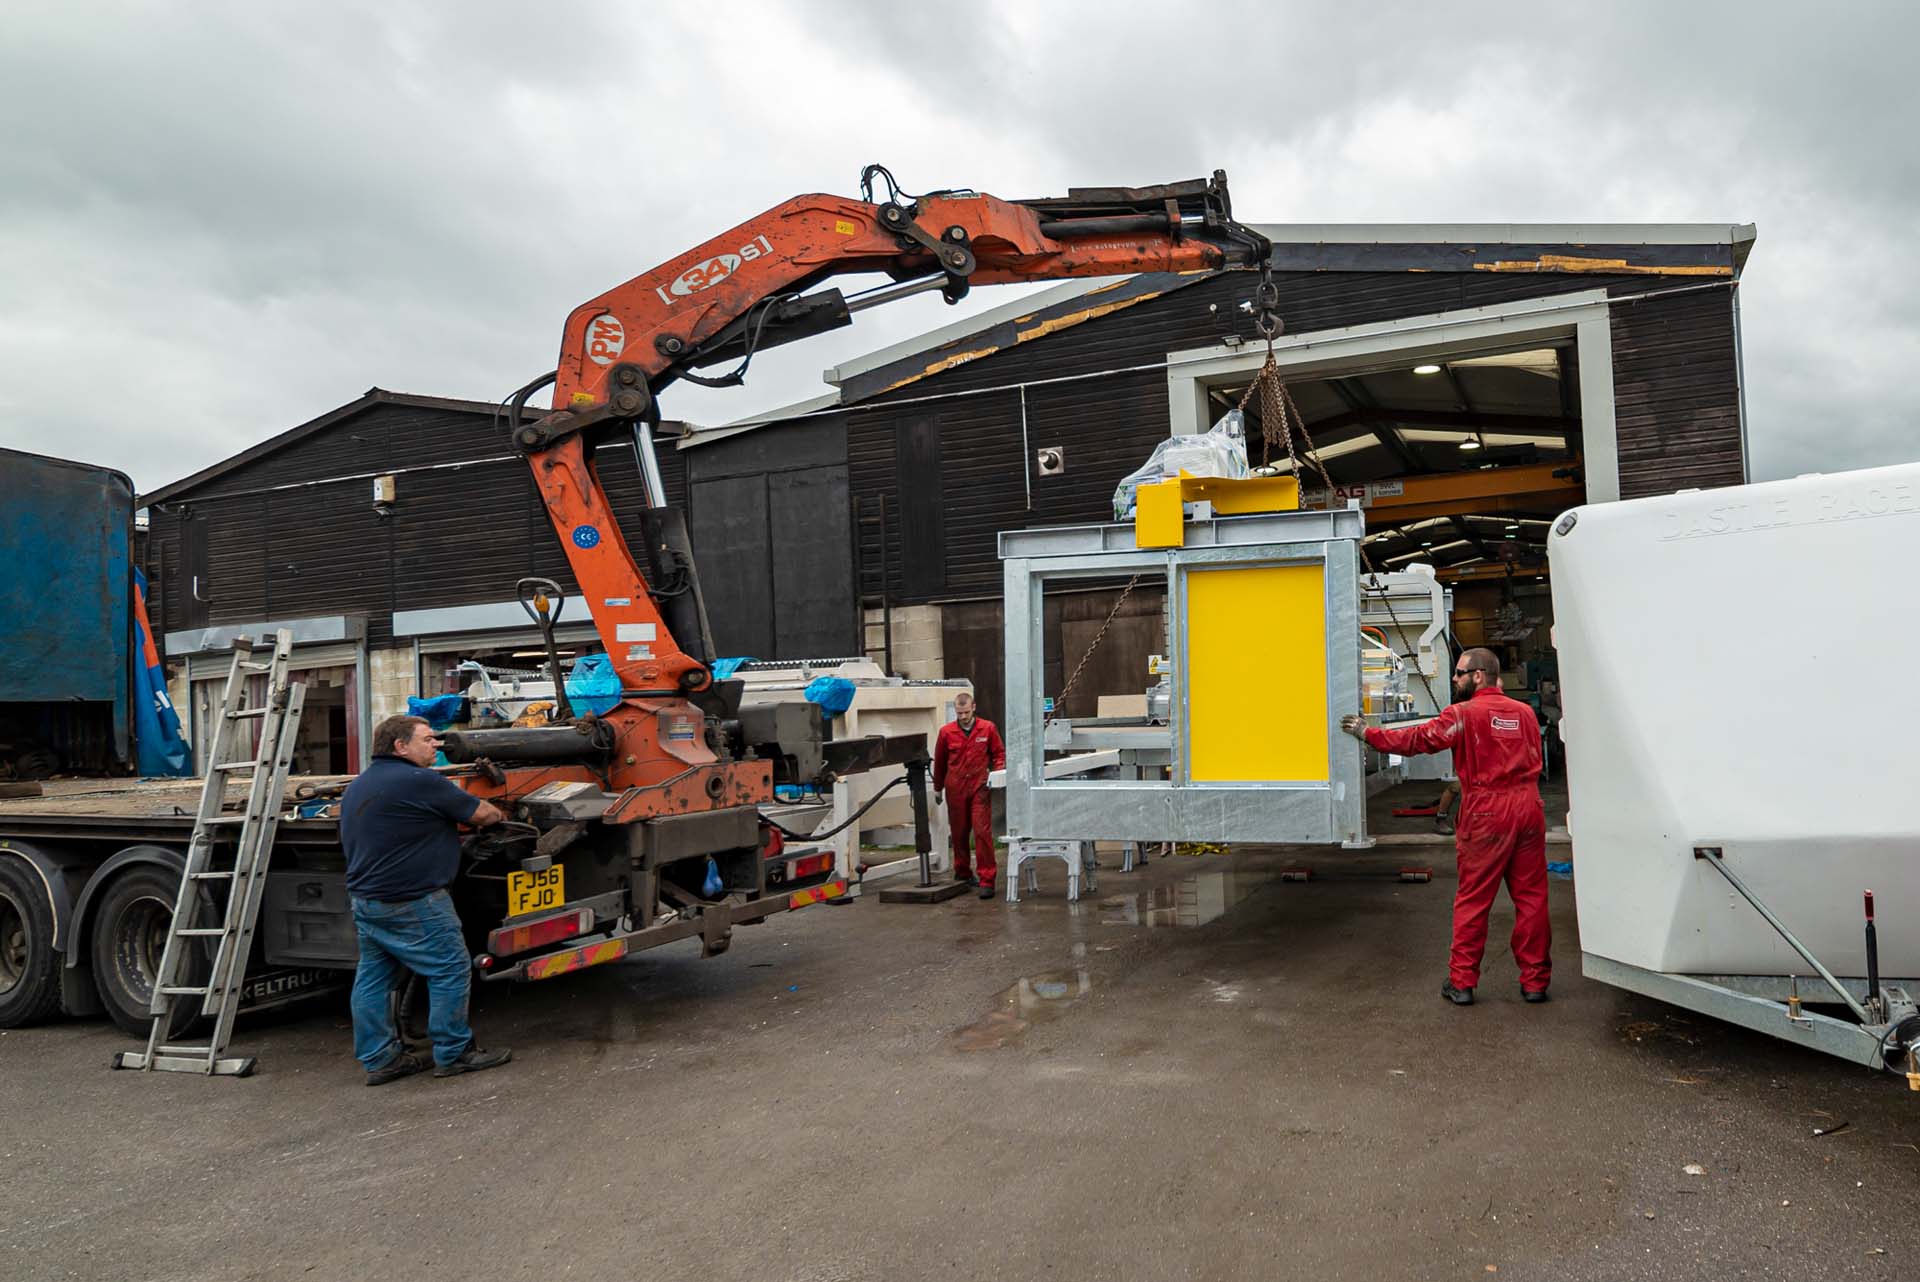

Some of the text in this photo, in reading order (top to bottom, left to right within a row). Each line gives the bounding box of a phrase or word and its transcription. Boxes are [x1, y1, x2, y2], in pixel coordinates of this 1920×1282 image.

[590, 319, 622, 359] PM
[1815, 484, 1920, 520] RACE
[513, 868, 560, 892] FJ56
[519, 888, 554, 911] FJO
